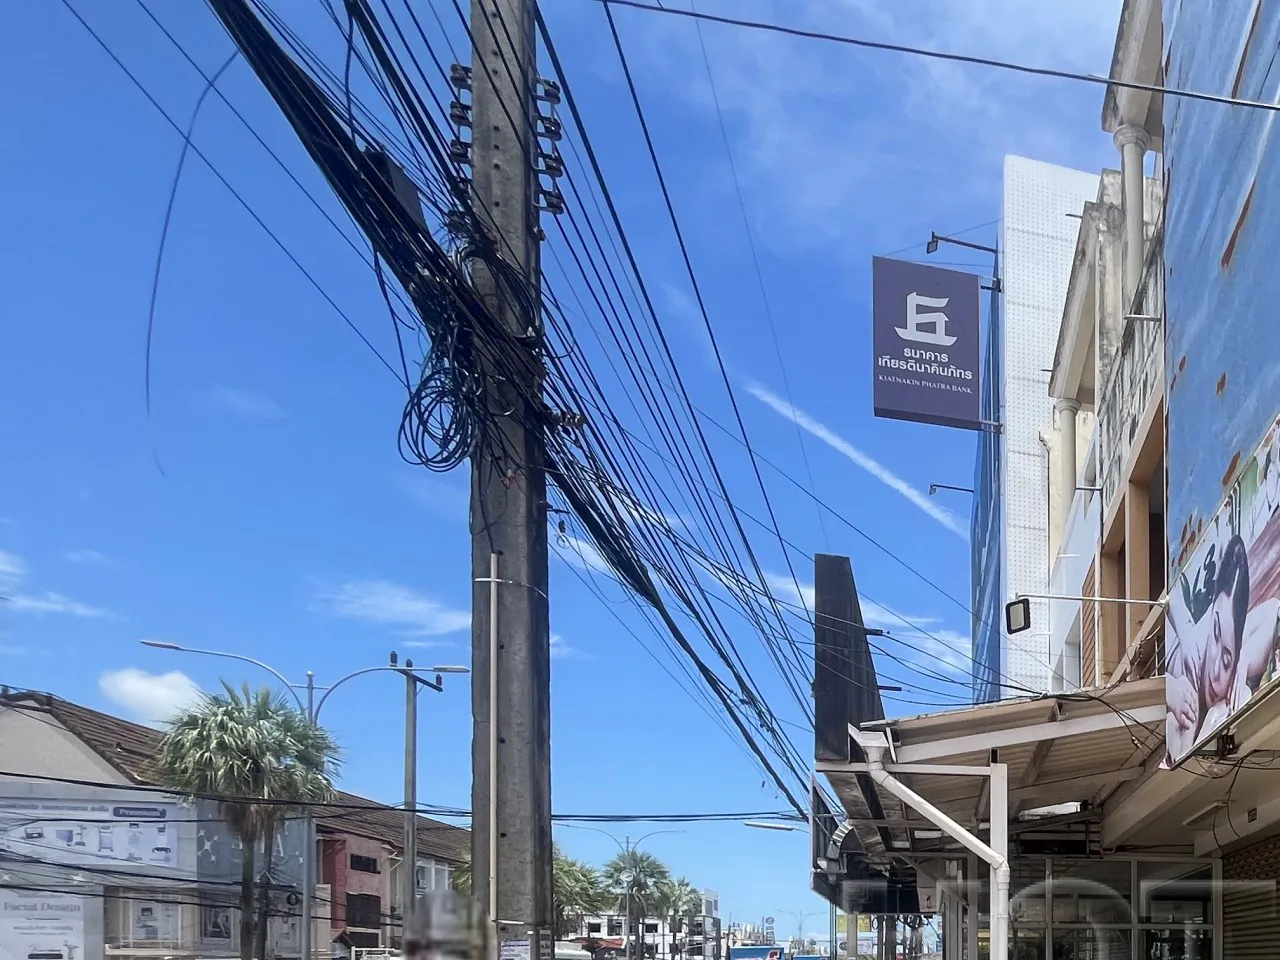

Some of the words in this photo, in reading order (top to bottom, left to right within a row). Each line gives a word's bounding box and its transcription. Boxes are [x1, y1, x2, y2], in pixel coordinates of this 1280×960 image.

[903, 348, 949, 363] ธนาคาร
[878, 355, 973, 379] เกียรตินาคินภัทร
[878, 374, 920, 387] KIATNAKIN
[921, 380, 951, 391] PHATRA
[952, 385, 973, 394] BANK
